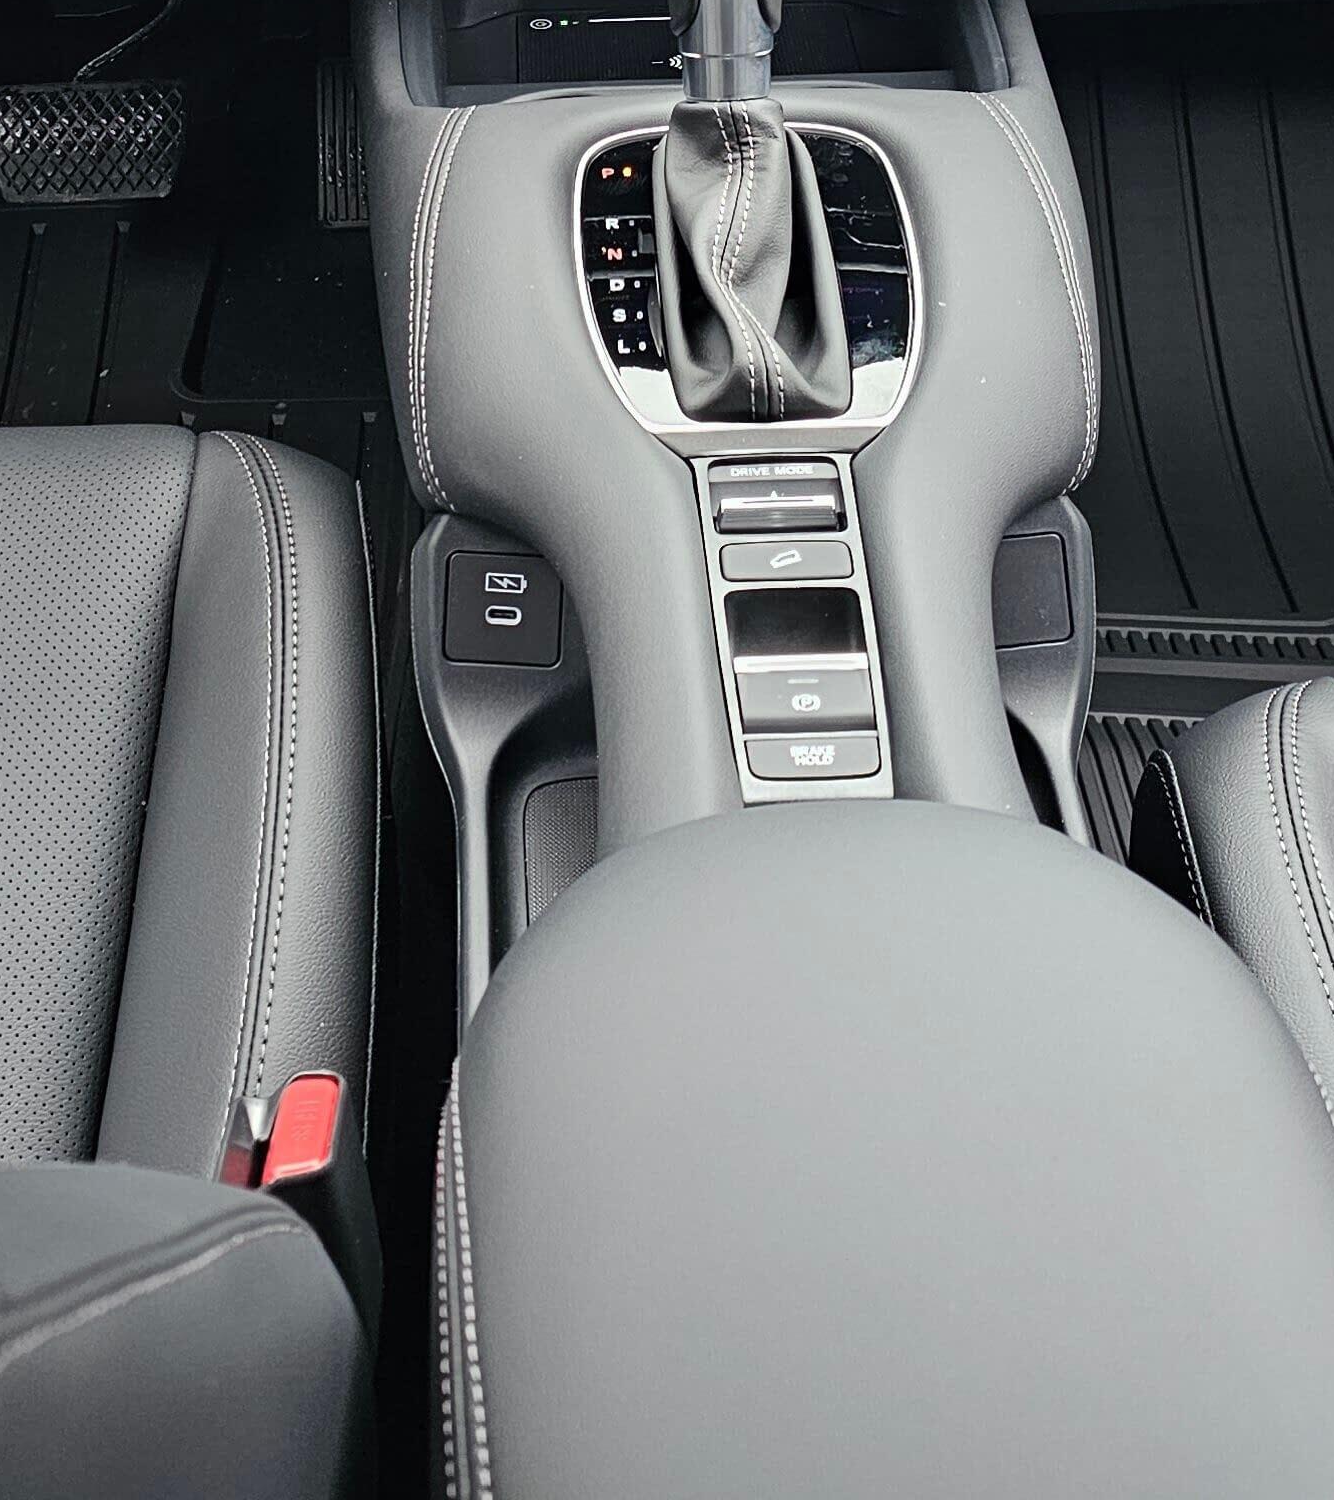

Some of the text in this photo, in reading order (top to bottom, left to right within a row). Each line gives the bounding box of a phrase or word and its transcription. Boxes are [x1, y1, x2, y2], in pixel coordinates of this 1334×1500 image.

[601, 167, 615, 179] P
[605, 217, 619, 230] R
[607, 247, 623, 260] N
[610, 278, 625, 292] D
[612, 308, 627, 323] S
[617, 339, 631, 354] L
[730, 465, 814, 477] DRIVE MODE
[790, 745, 836, 757] BRAKE
[794, 755, 834, 766] HOLD
